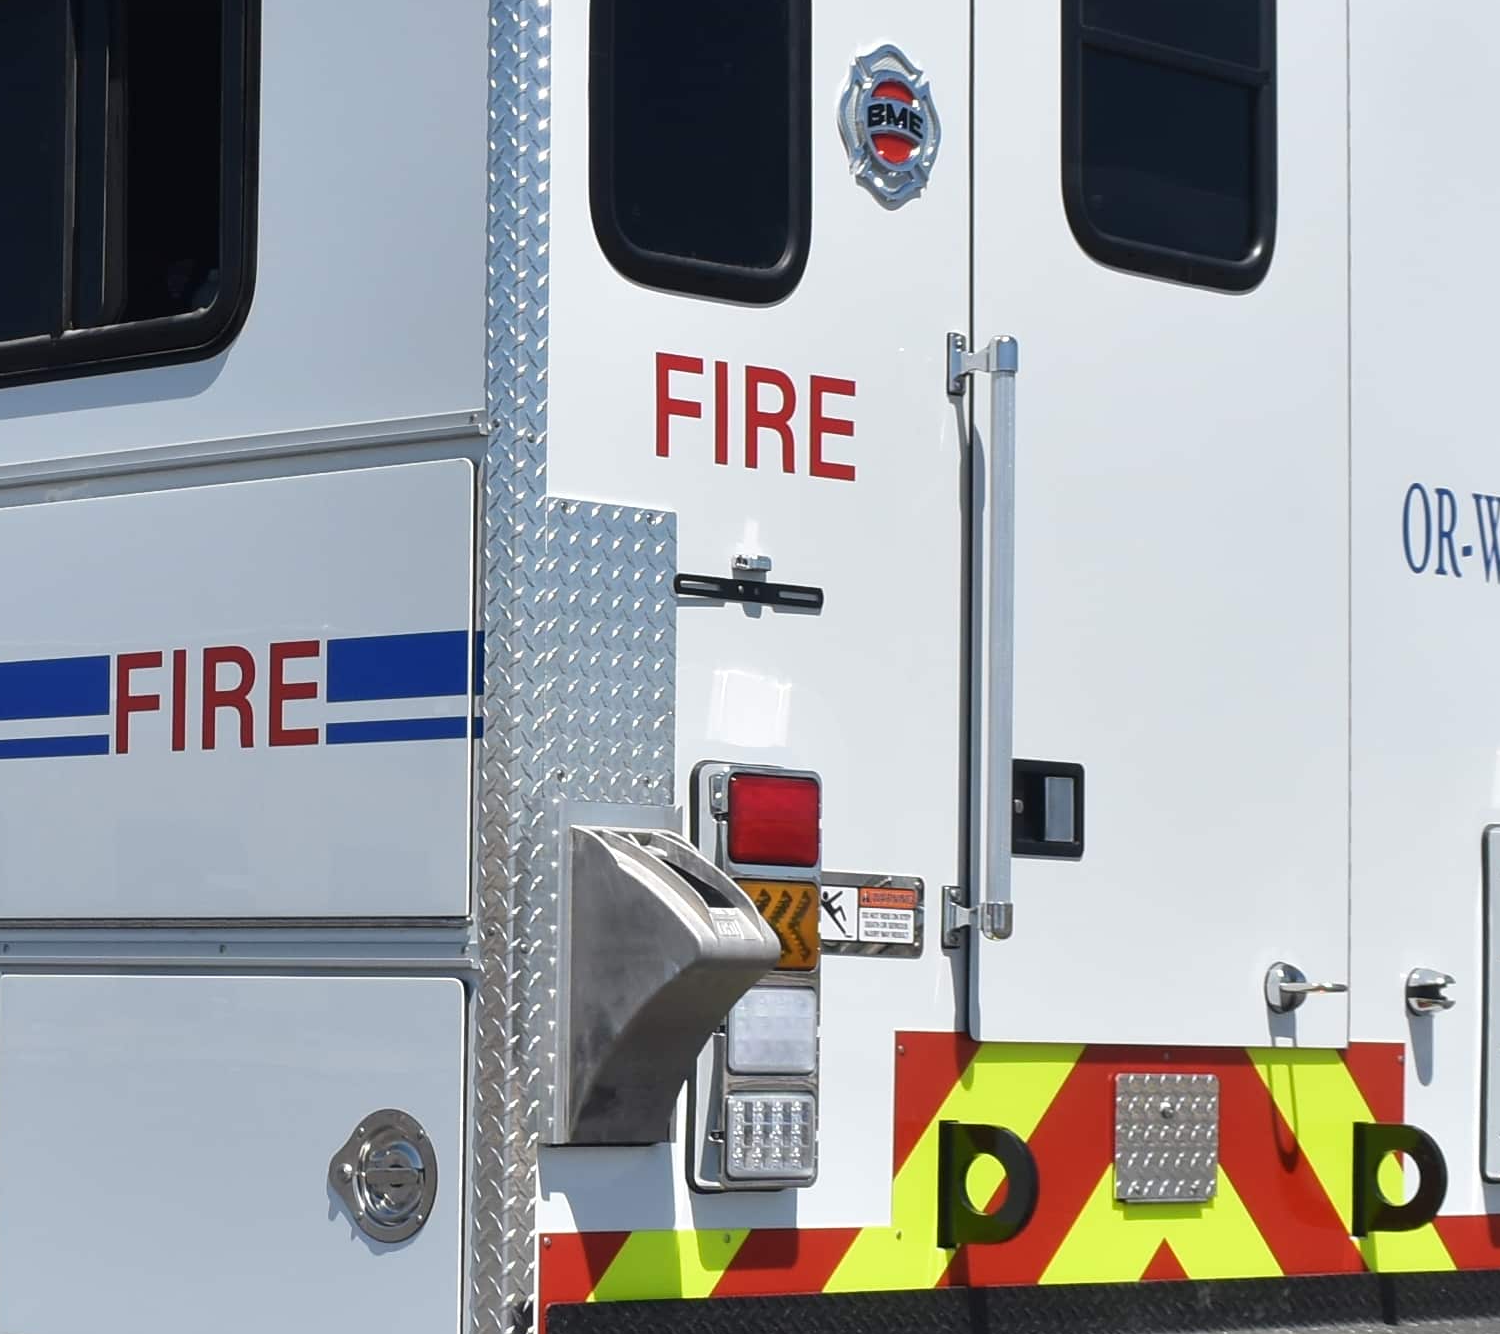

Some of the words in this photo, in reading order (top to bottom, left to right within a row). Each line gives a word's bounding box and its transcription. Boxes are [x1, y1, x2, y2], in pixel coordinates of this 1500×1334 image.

[866, 102, 924, 140] BME
[654, 351, 858, 482] FIRE
[113, 639, 322, 755] FIRE
